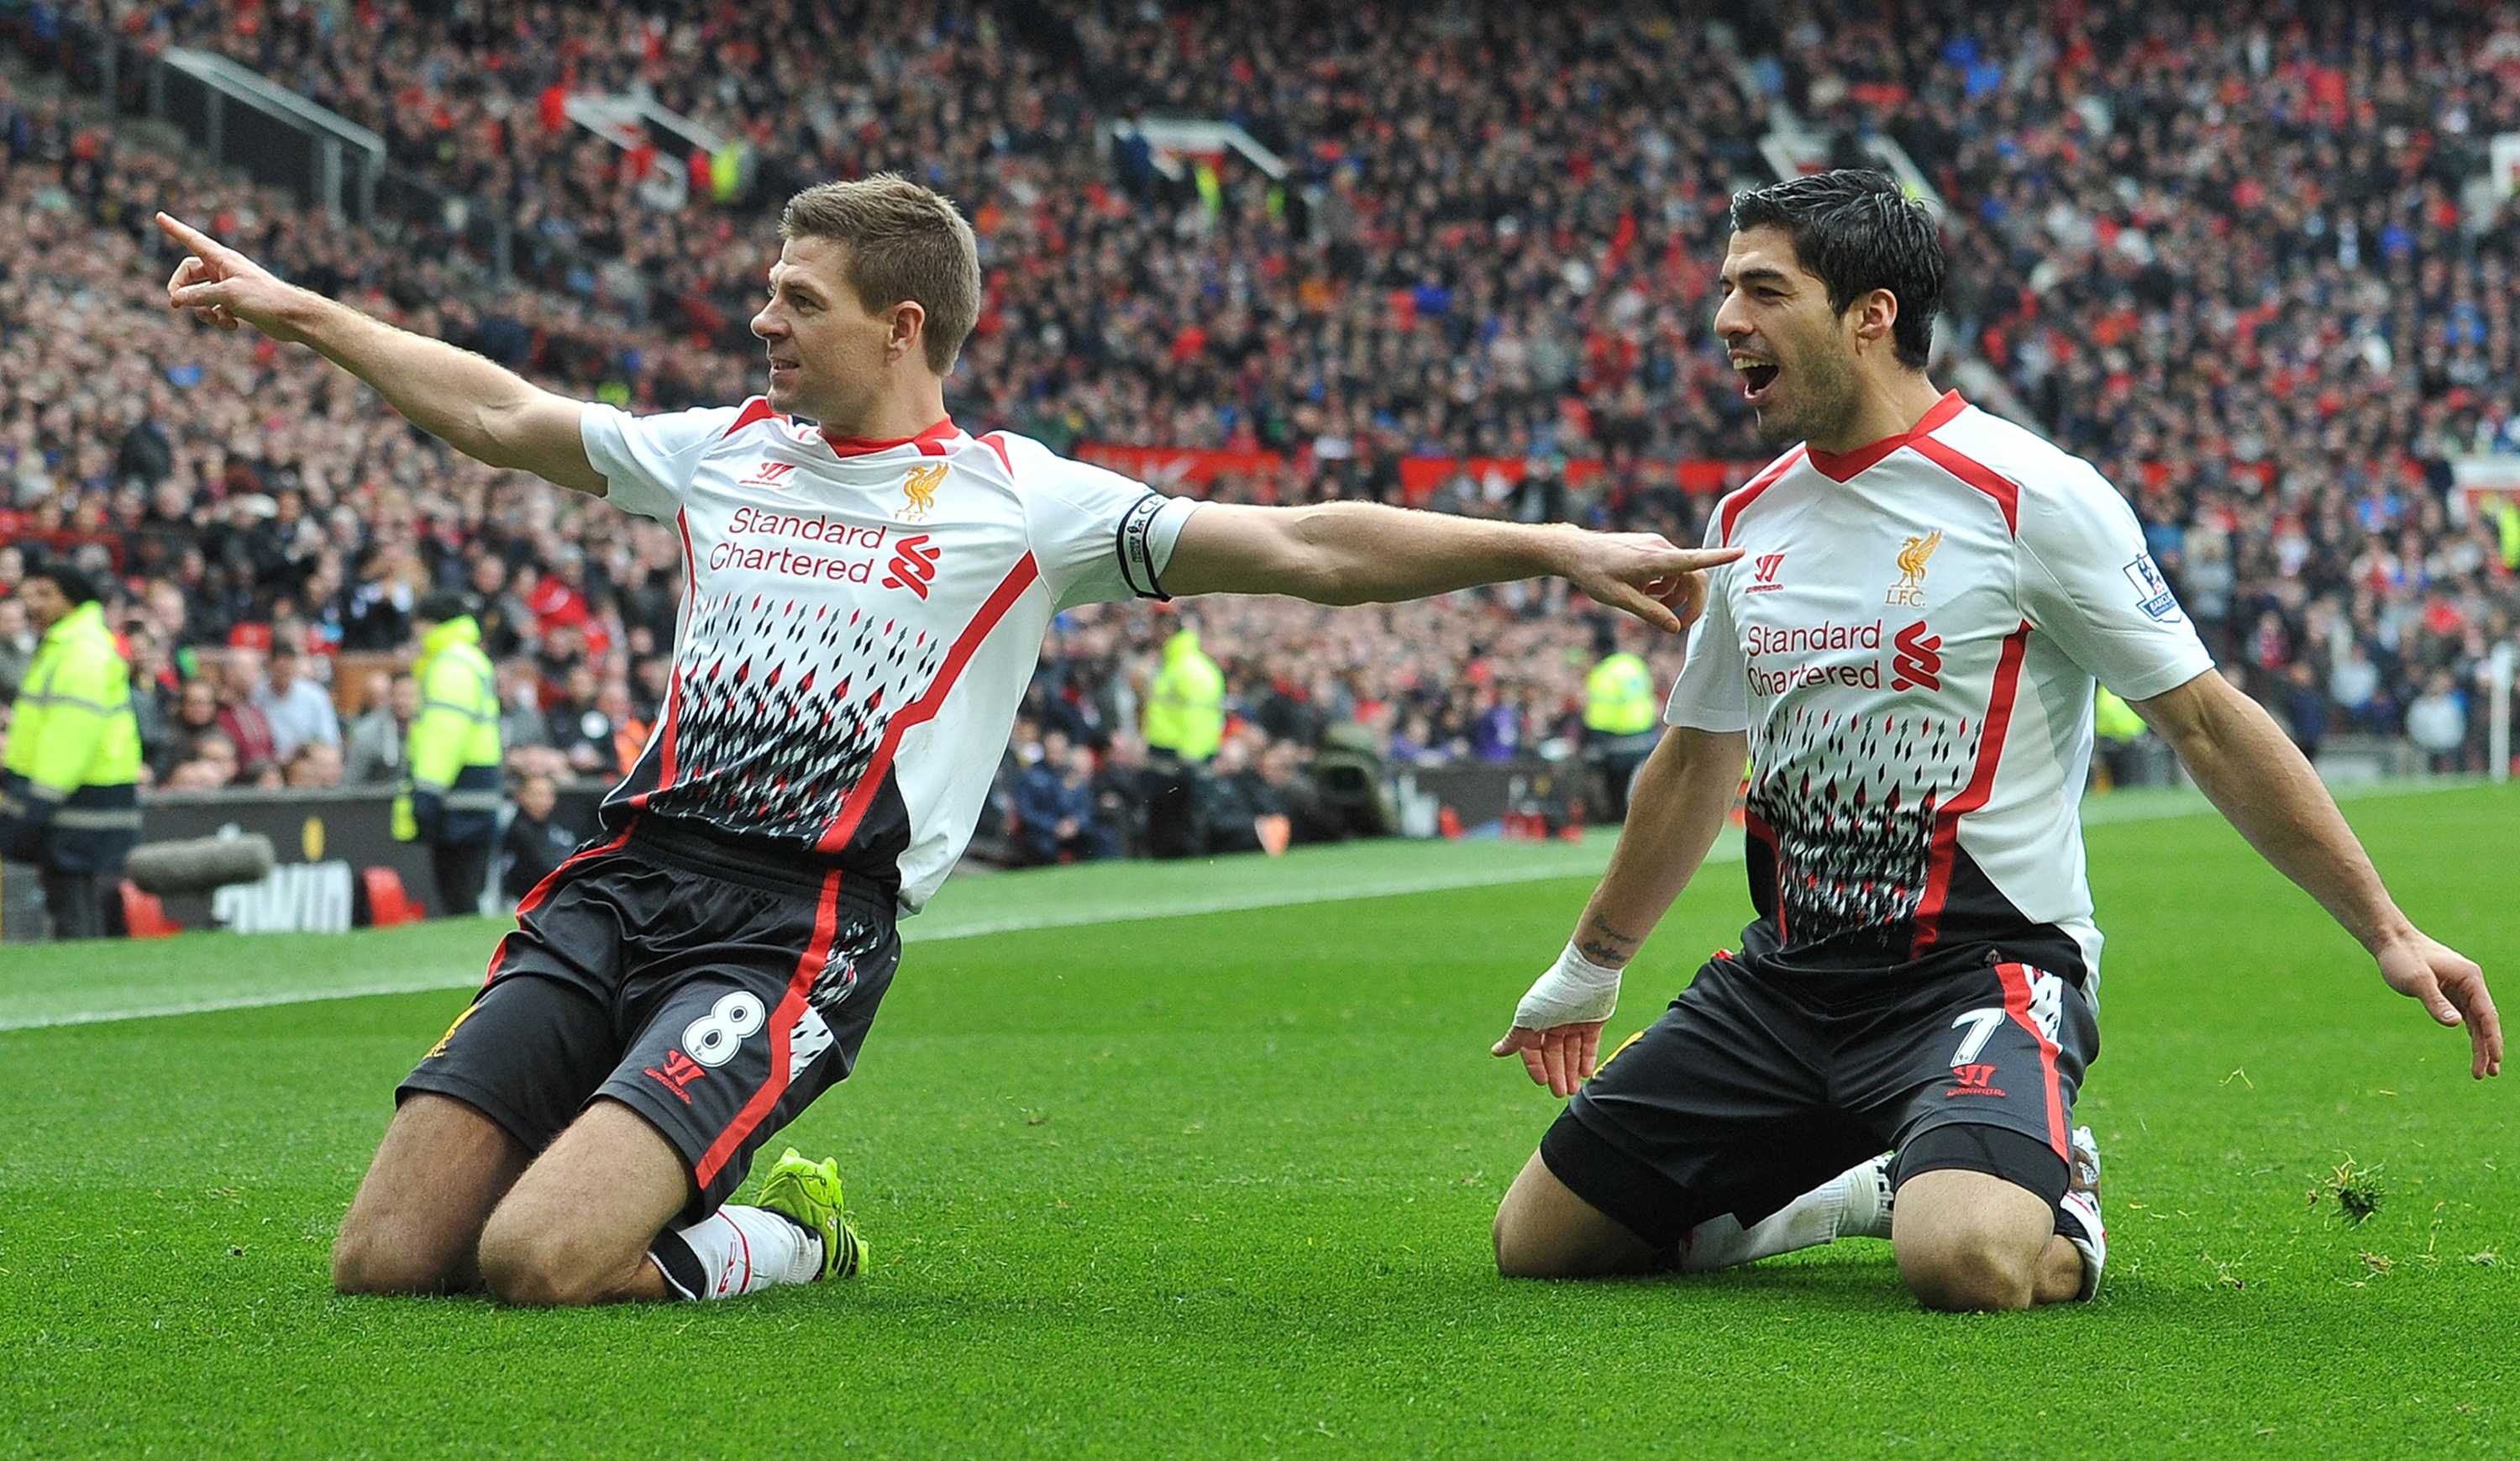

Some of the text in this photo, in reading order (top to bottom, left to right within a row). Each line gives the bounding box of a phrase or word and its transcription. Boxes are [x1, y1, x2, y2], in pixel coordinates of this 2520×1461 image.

[728, 507, 886, 549] Standard
[710, 542, 874, 584] Chartered
[1747, 619, 1882, 657] Standard
[1747, 660, 1881, 697] Chartered
[681, 991, 766, 1068] 8
[1950, 1007, 2006, 1068] 7
